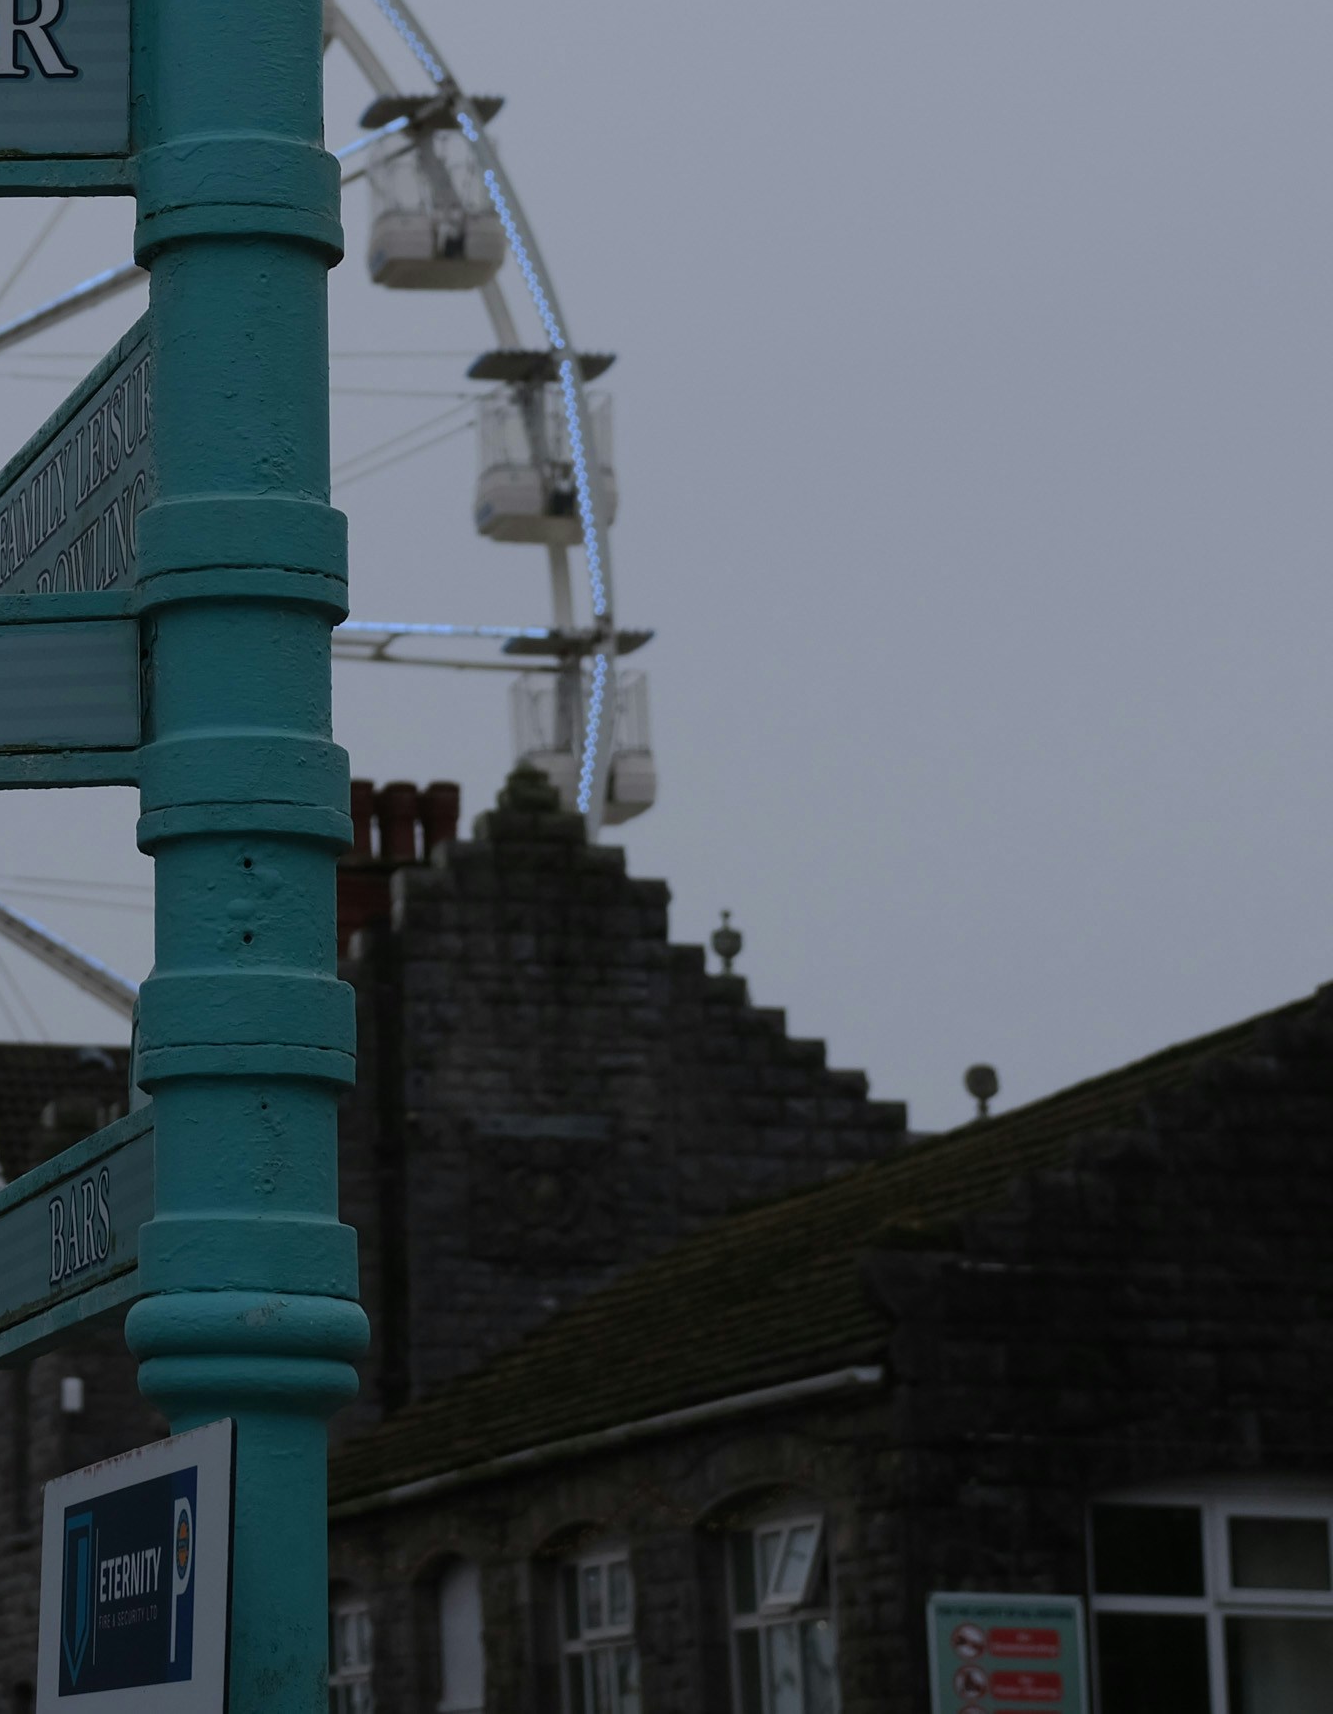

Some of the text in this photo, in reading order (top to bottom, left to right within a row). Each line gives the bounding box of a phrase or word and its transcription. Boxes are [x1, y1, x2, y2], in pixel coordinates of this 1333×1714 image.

[48, 1165, 111, 1285] BARS
[99, 1546, 162, 1603] ETERNITY
[117, 1606, 145, 1627] SECURITY
